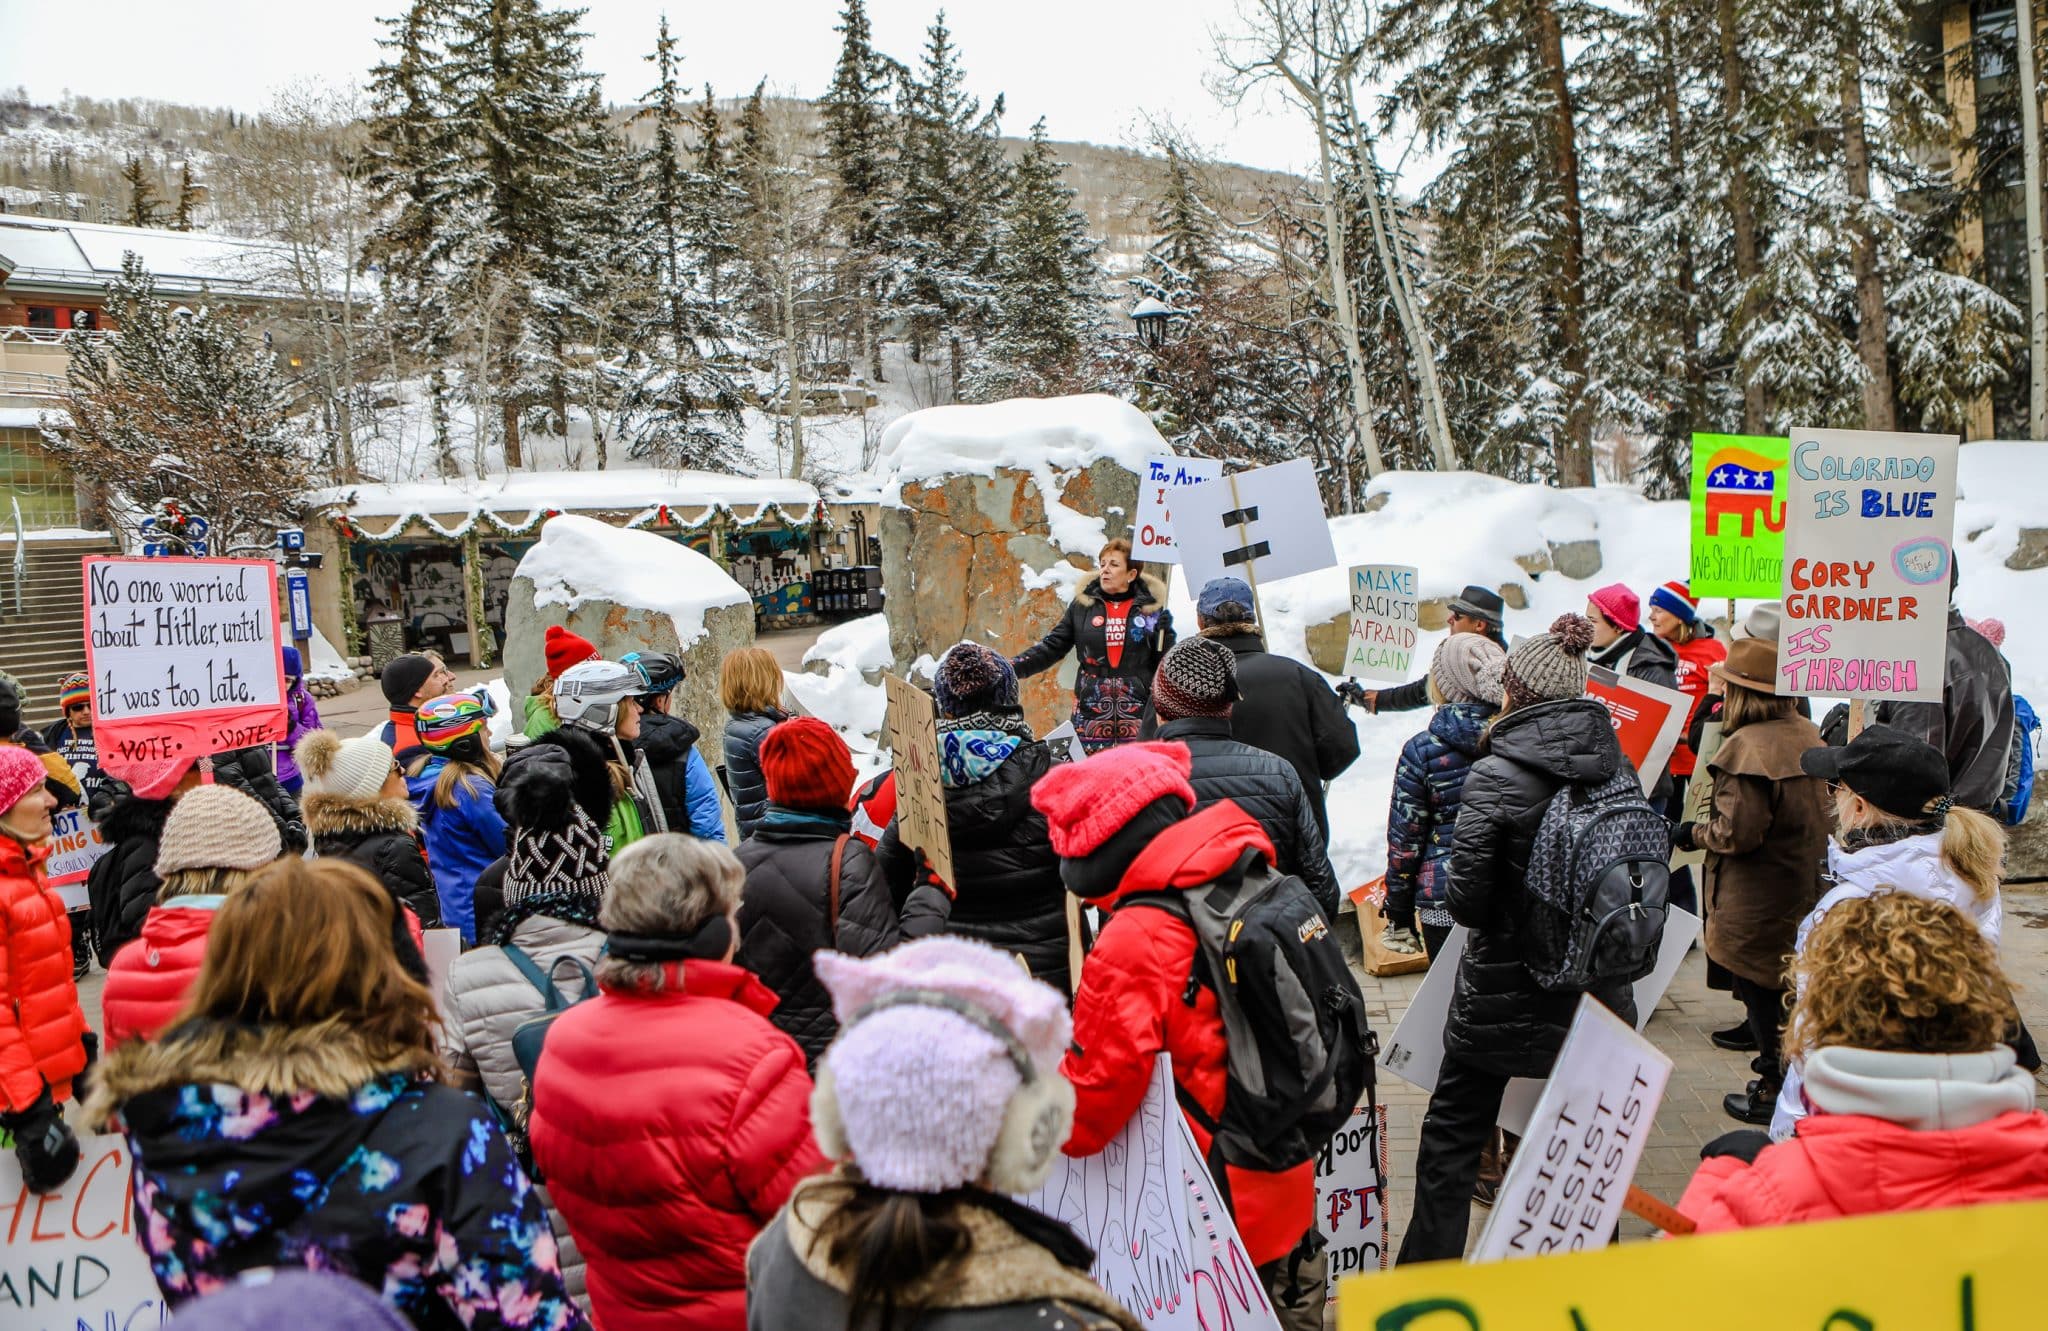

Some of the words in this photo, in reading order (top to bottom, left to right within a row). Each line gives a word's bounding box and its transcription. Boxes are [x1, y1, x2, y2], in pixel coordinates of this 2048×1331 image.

[1814, 490, 1849, 519] IS
[1861, 488, 1937, 519] BLUE
[1691, 543, 1711, 580] We
[1713, 544, 1739, 582] Shall
[1744, 545, 1784, 583] Overco
[1790, 558, 1875, 591] CORY
[91, 564, 119, 606] No
[127, 579, 163, 603] one
[169, 567, 248, 603] worried
[1357, 570, 1413, 595] MAKE
[1352, 594, 1417, 622] RACISTS
[1786, 594, 1918, 622] GARDNER
[91, 609, 145, 649] about
[154, 606, 219, 649] Hitler,
[223, 608, 264, 644] until
[1351, 619, 1416, 649] AFRAID
[1788, 624, 1832, 657] IS
[1352, 647, 1409, 671] AGAIN
[1782, 658, 1918, 692] THROUGH
[97, 670, 117, 715] it
[122, 690, 160, 710] was
[166, 664, 200, 707] too
[206, 658, 256, 704] late.
[1505, 1102, 1577, 1259] NSIST
[0, 1255, 110, 1308] AND
